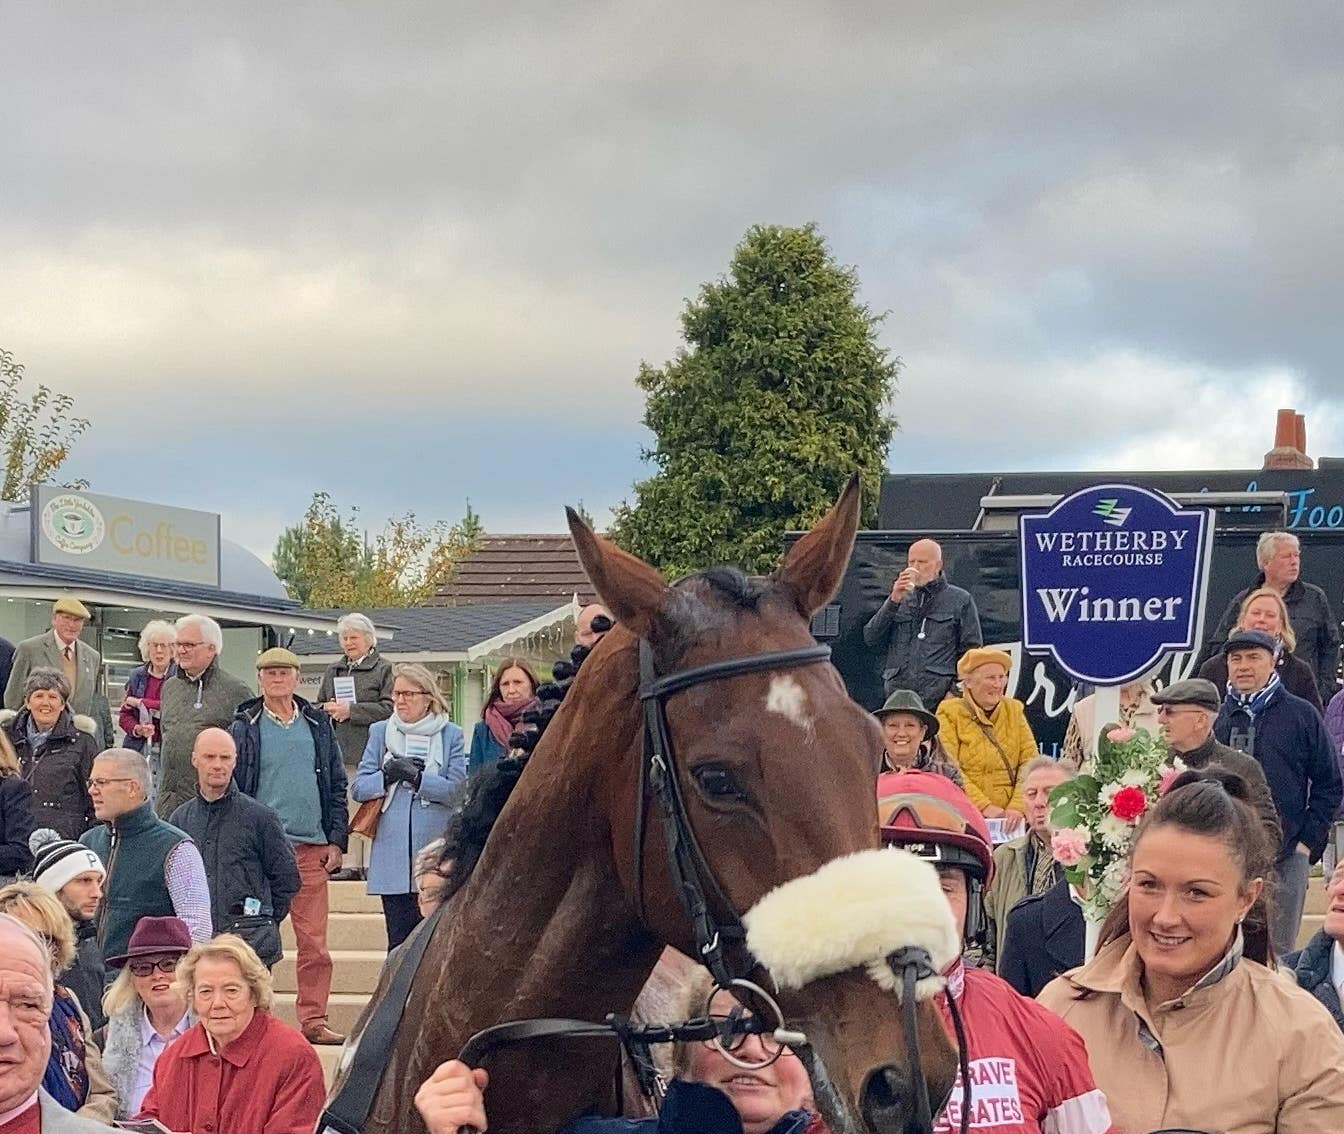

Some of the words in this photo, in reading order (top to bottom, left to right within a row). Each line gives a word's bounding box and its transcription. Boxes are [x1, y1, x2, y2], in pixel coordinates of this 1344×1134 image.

[109, 513, 208, 565] Coffee
[1035, 530, 1188, 553] WETHERBY
[1062, 553, 1163, 566] RACECOURSE
[1036, 586, 1184, 623] Winner
[87, 853, 97, 867] P
